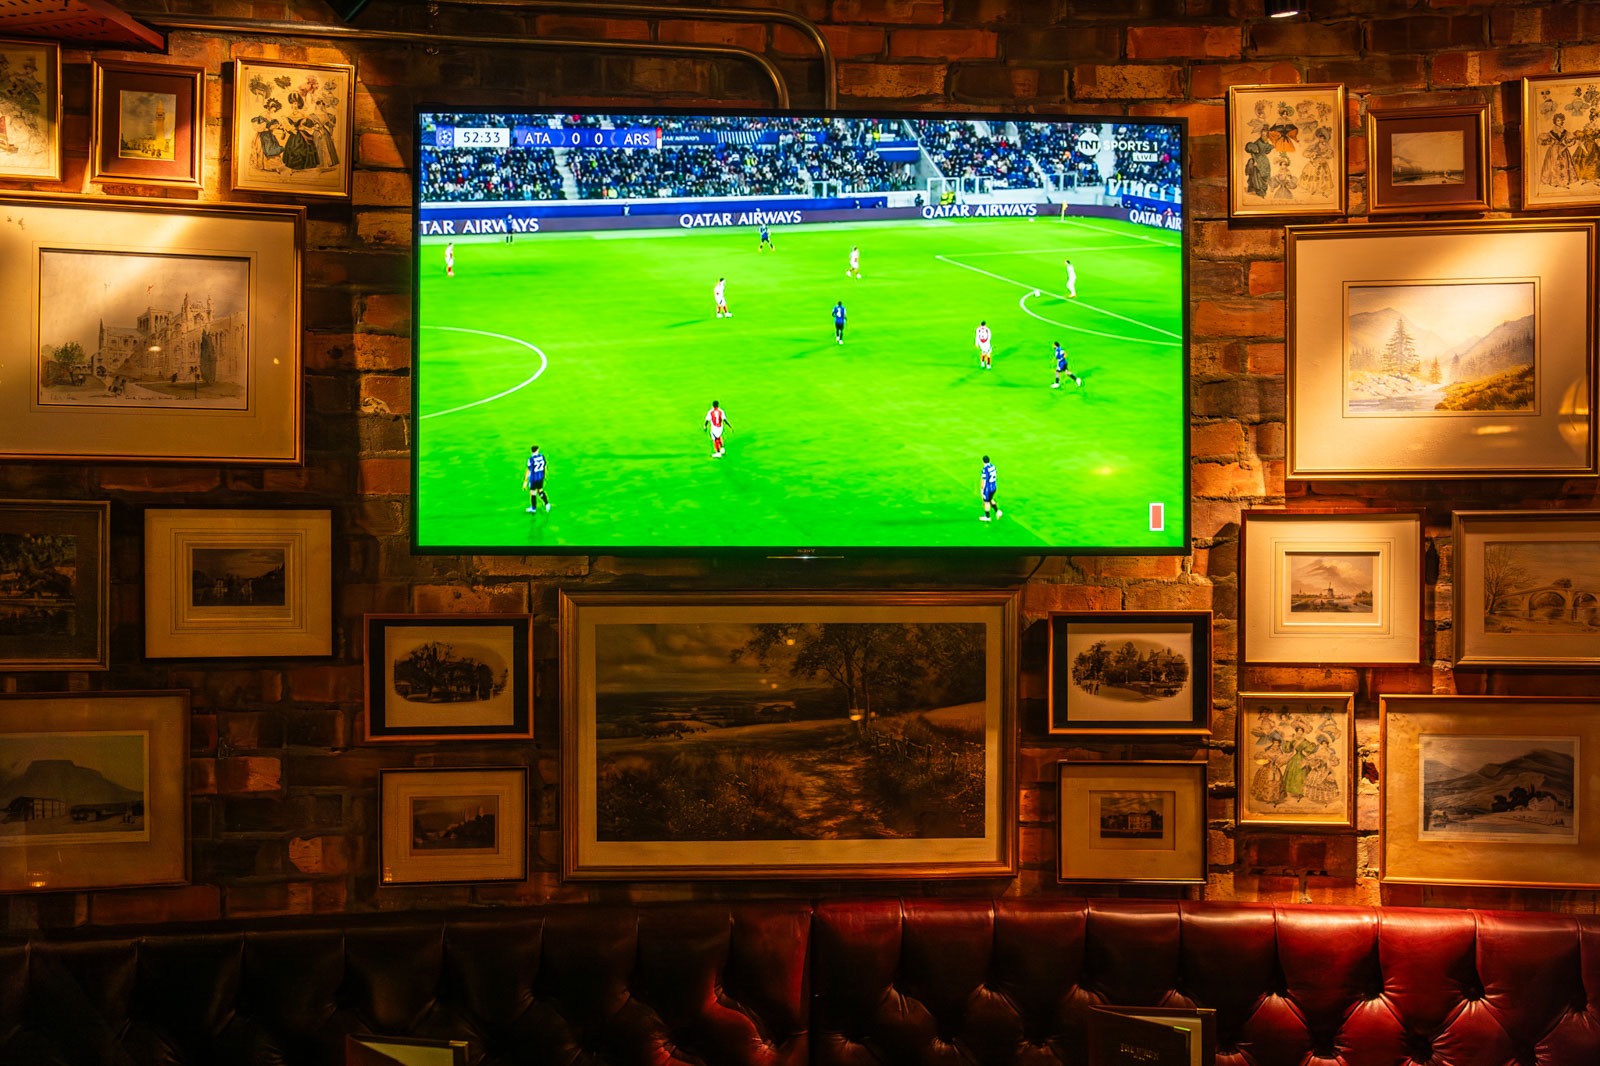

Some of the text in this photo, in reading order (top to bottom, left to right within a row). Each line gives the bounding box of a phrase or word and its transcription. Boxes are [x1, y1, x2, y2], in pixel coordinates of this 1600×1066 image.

[463, 131, 501, 144] 52:33
[524, 132, 651, 146] ATA 0 0 ARS
[1103, 140, 1151, 151] SPORTS
[1152, 141, 1159, 152] 1
[679, 210, 802, 228] QATAR AIRWAYS
[922, 203, 1038, 219] QATAR AIRWAYS
[420, 218, 539, 235] TAR AIRWAYS
[1129, 208, 1182, 231] QATAR AIR
